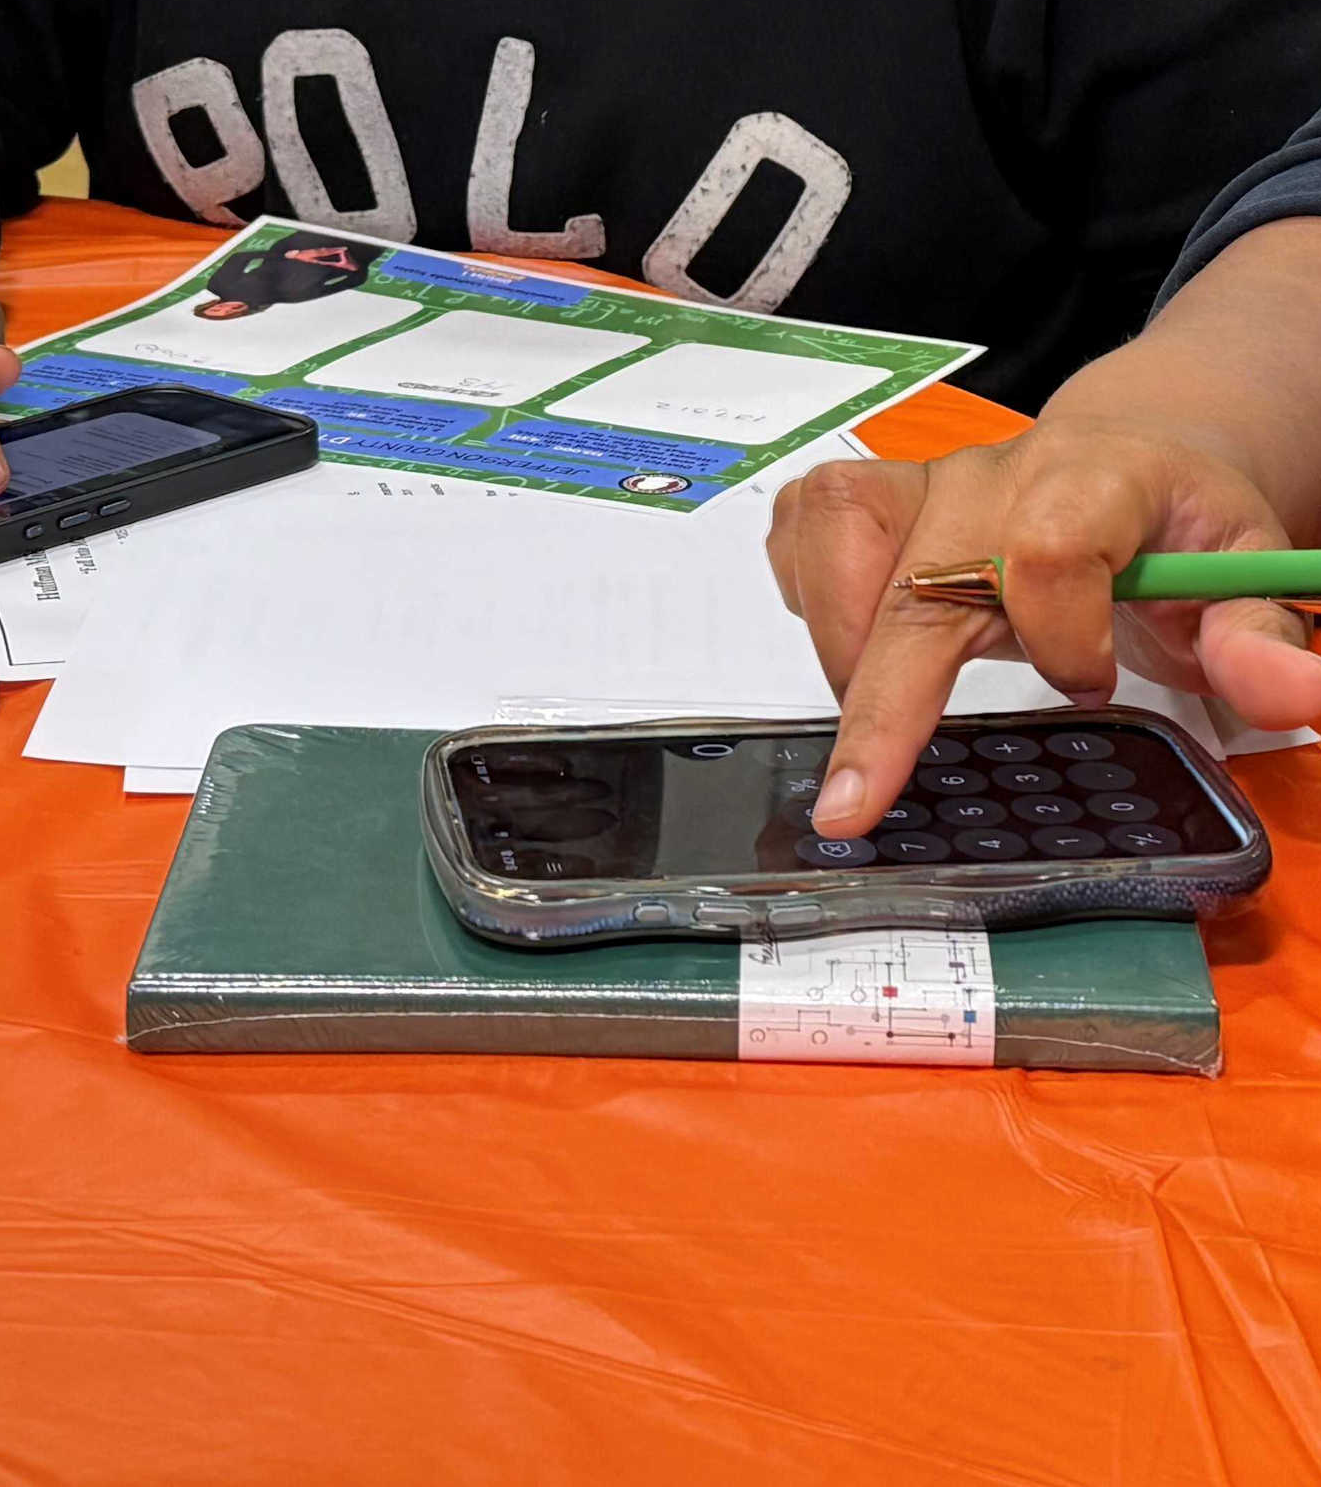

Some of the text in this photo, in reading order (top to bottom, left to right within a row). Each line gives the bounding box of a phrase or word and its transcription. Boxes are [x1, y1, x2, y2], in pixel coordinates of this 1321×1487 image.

[131, 27, 852, 313] POLO
[353, 439, 590, 474] JEFFERSON COUNTY
[1016, 773, 1040, 784] 3
[942, 774, 1001, 851] 4 5 6
[1036, 803, 1060, 814] 2
[1111, 801, 1135, 812] 0
[900, 839, 927, 853] 7
